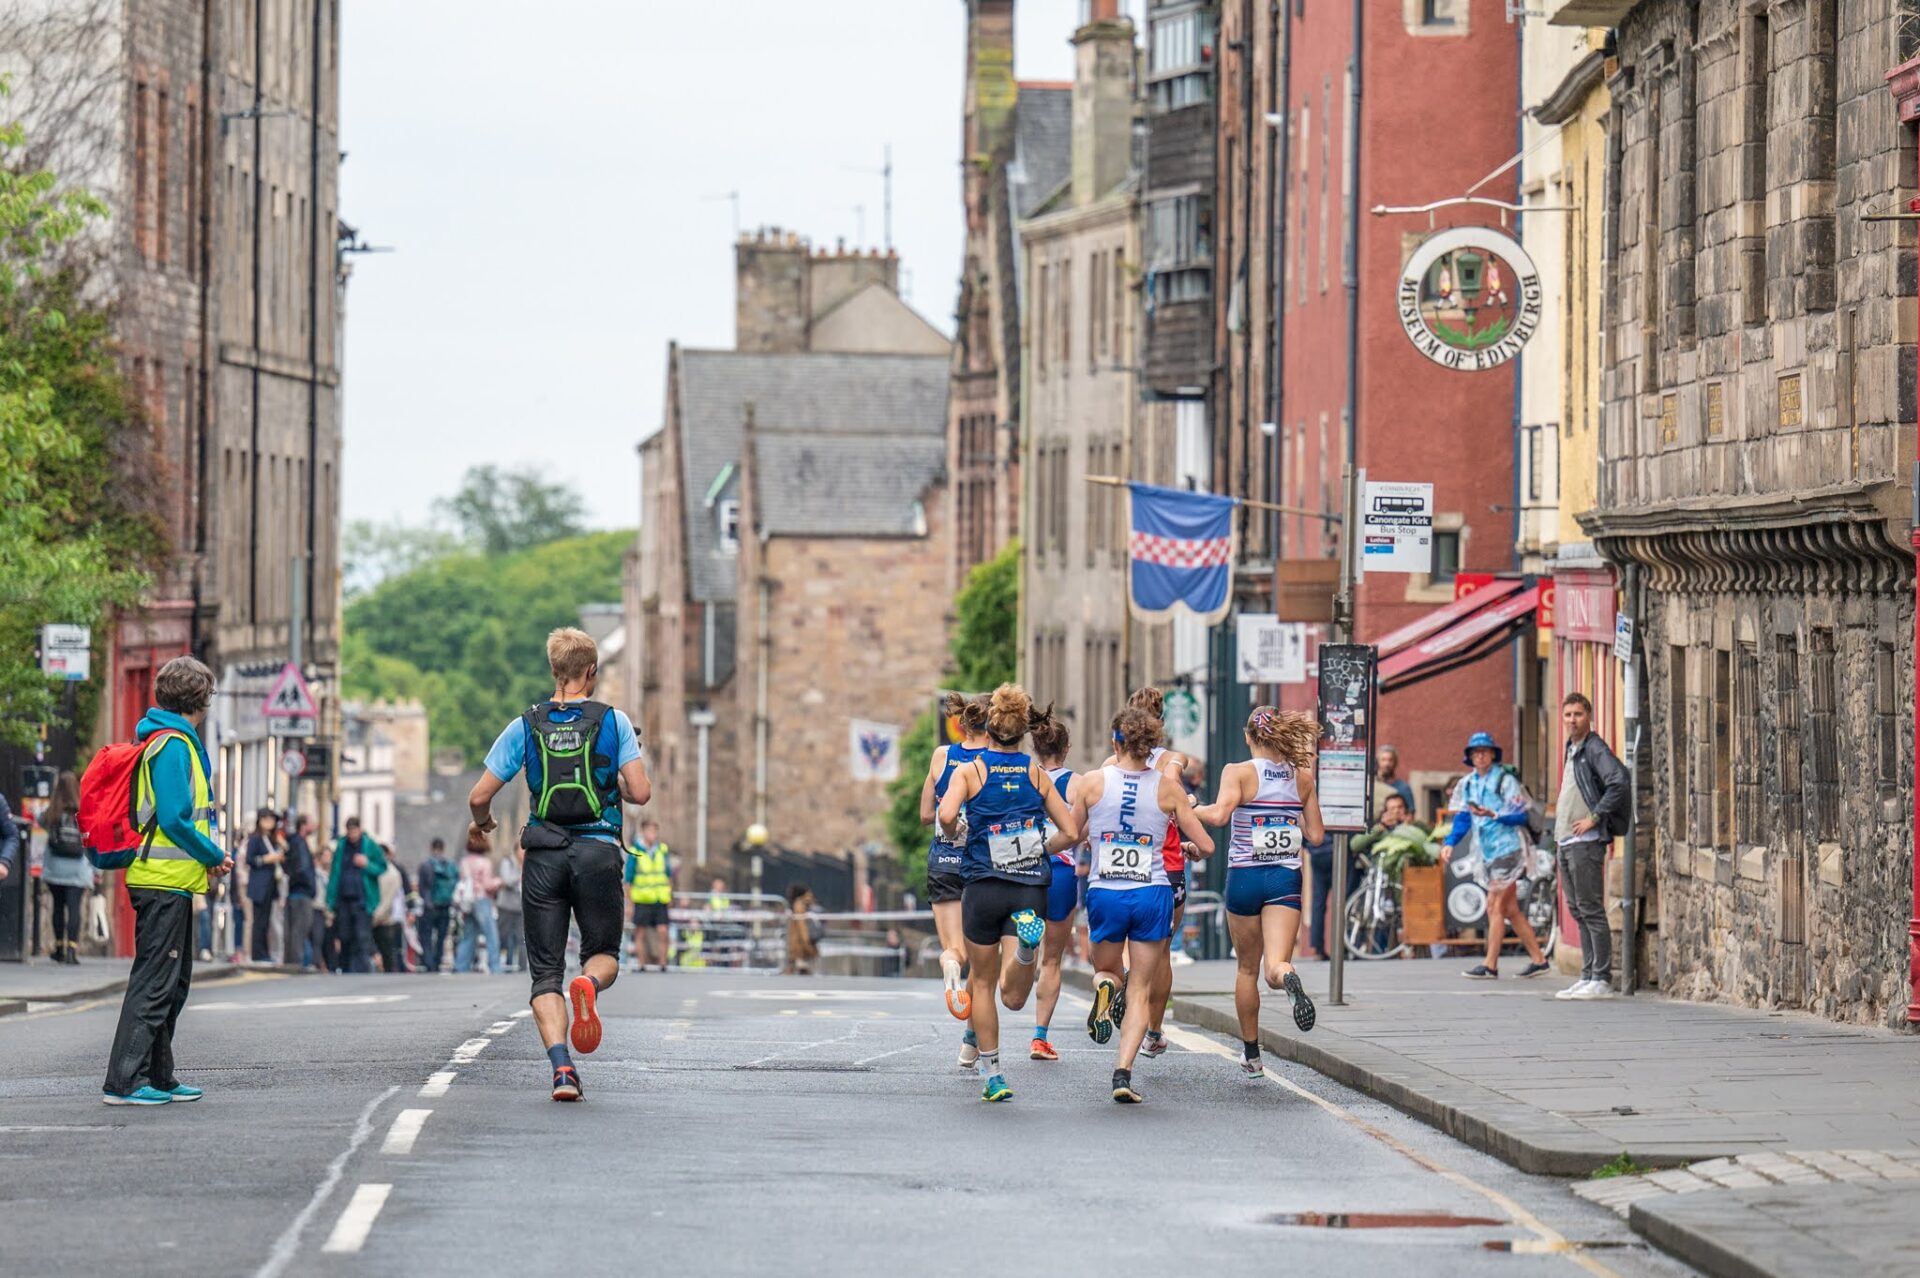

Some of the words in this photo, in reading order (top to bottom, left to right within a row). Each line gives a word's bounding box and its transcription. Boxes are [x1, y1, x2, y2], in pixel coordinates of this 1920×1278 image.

[1400, 276, 1443, 358] MUSEUM
[1444, 351, 1466, 369] OF
[1474, 273, 1541, 369] EDINBURGH
[1368, 515, 1411, 526] Canongate
[1412, 516, 1429, 526] Kirk
[1380, 526, 1396, 534] Bus
[1398, 527, 1417, 536] Stop
[989, 765, 1028, 774] SWEDEN
[1264, 769, 1291, 779] FRANCE
[1264, 830, 1292, 849] 35
[1010, 837, 1022, 856] 1
[1111, 848, 1140, 868] 20
[1259, 853, 1295, 862] EDINBURGH
